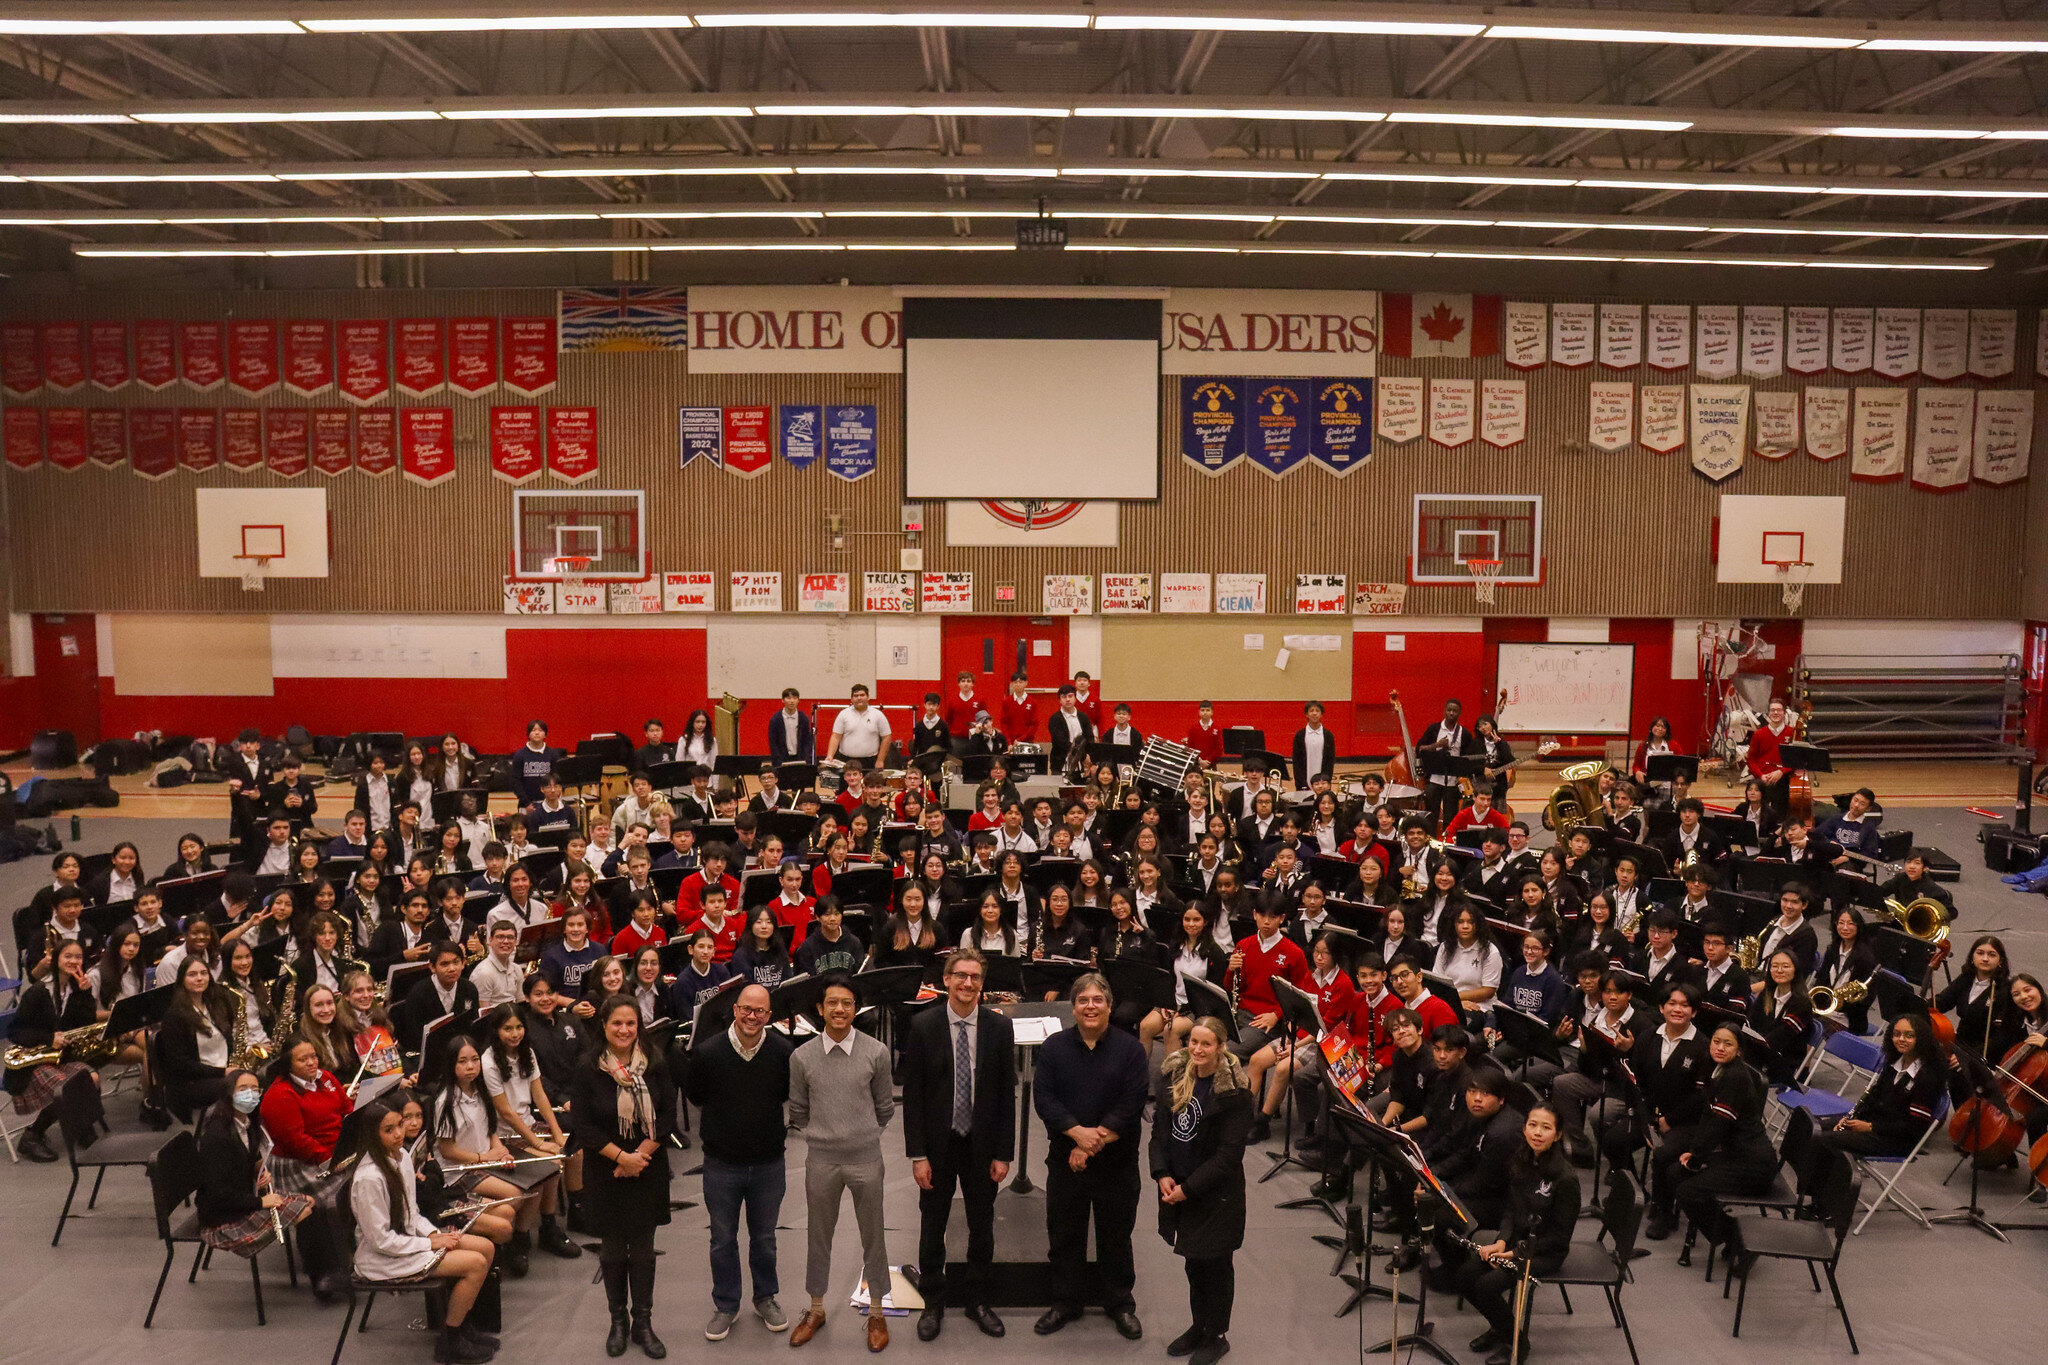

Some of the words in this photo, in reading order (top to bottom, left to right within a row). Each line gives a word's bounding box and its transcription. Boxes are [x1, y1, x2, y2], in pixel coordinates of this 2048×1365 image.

[689, 310, 844, 350] HOME
[1710, 397, 1742, 405] CATHOLIC
[1699, 410, 1738, 418] PROVINCIAL
[1699, 417, 1739, 425] CHAMPIONS
[1700, 429, 1736, 446] VOLLEYBALL
[691, 440, 711, 448] 2022
[731, 576, 749, 586] #7
[753, 576, 778, 585] HITS
[923, 573, 944, 583] When
[1105, 578, 1133, 587] RENEE
[1326, 575, 1344, 587] the
[745, 587, 770, 595] FROM
[939, 583, 952, 591] the
[1357, 583, 1388, 595] WATCH
[997, 587, 1014, 600] EXIT
[1107, 588, 1125, 598] BAE
[1130, 588, 1138, 597] IS
[564, 595, 597, 606] STAR
[735, 598, 778, 606] HEAVEN
[866, 597, 901, 611] BLESS
[1103, 599, 1129, 609] GONNA
[1356, 594, 1372, 604] #3
[1368, 602, 1401, 614] SCORE!
